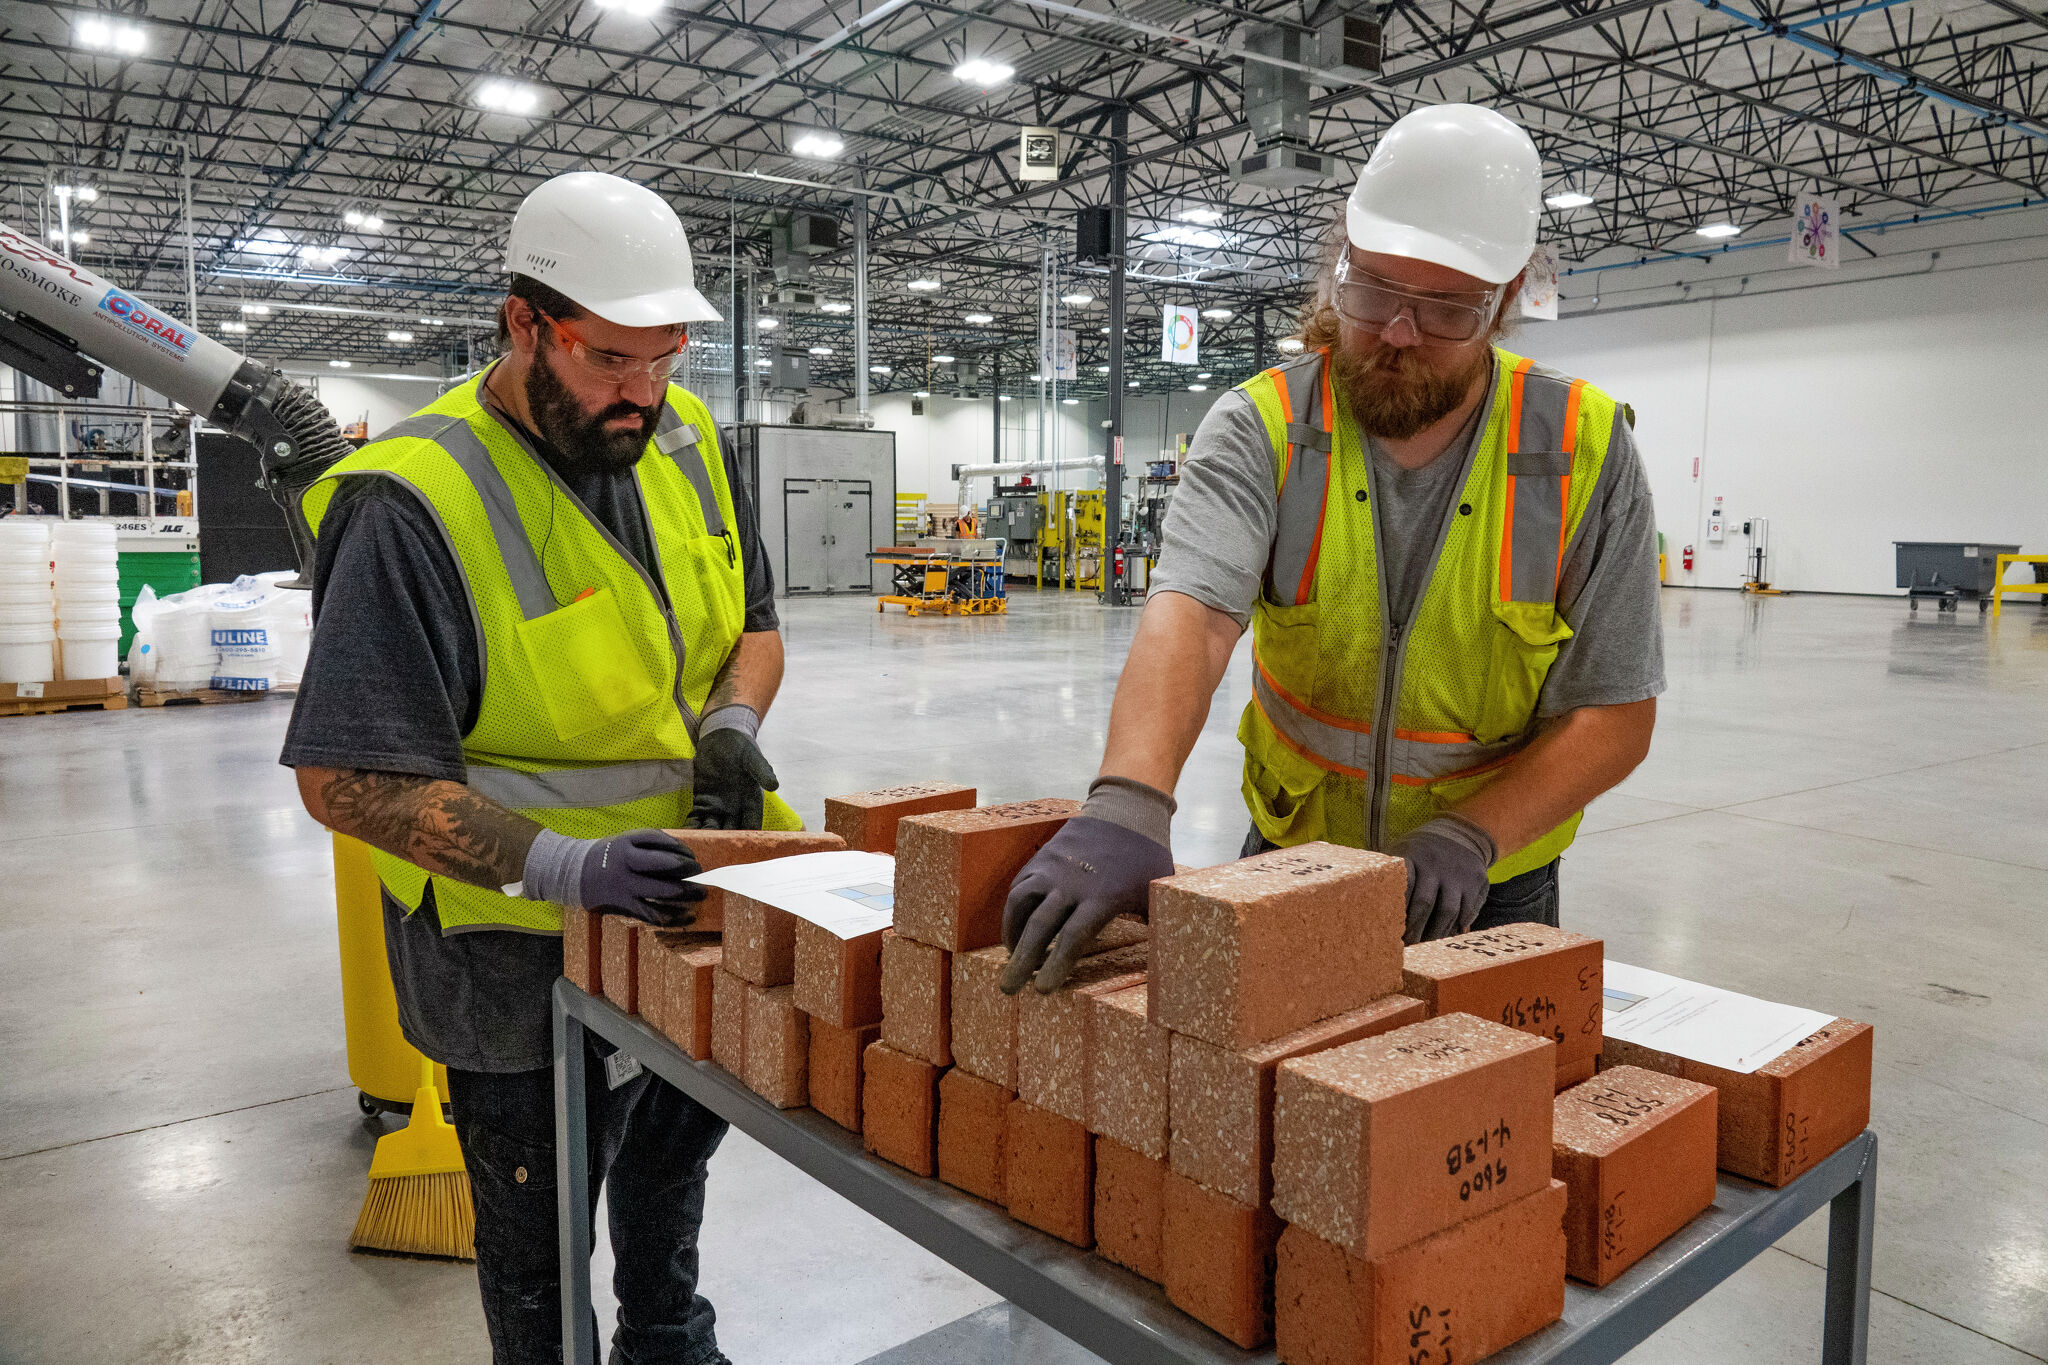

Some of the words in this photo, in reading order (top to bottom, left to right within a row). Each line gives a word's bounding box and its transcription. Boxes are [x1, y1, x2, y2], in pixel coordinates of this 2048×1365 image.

[0, 255, 81, 306] O-SMOKE
[93, 311, 149, 343] ANTIPOLLUTION
[151, 341, 185, 362] SYSTEMS
[109, 298, 186, 348] CORAL
[159, 524, 184, 533] JLG
[214, 631, 265, 644] ULINE
